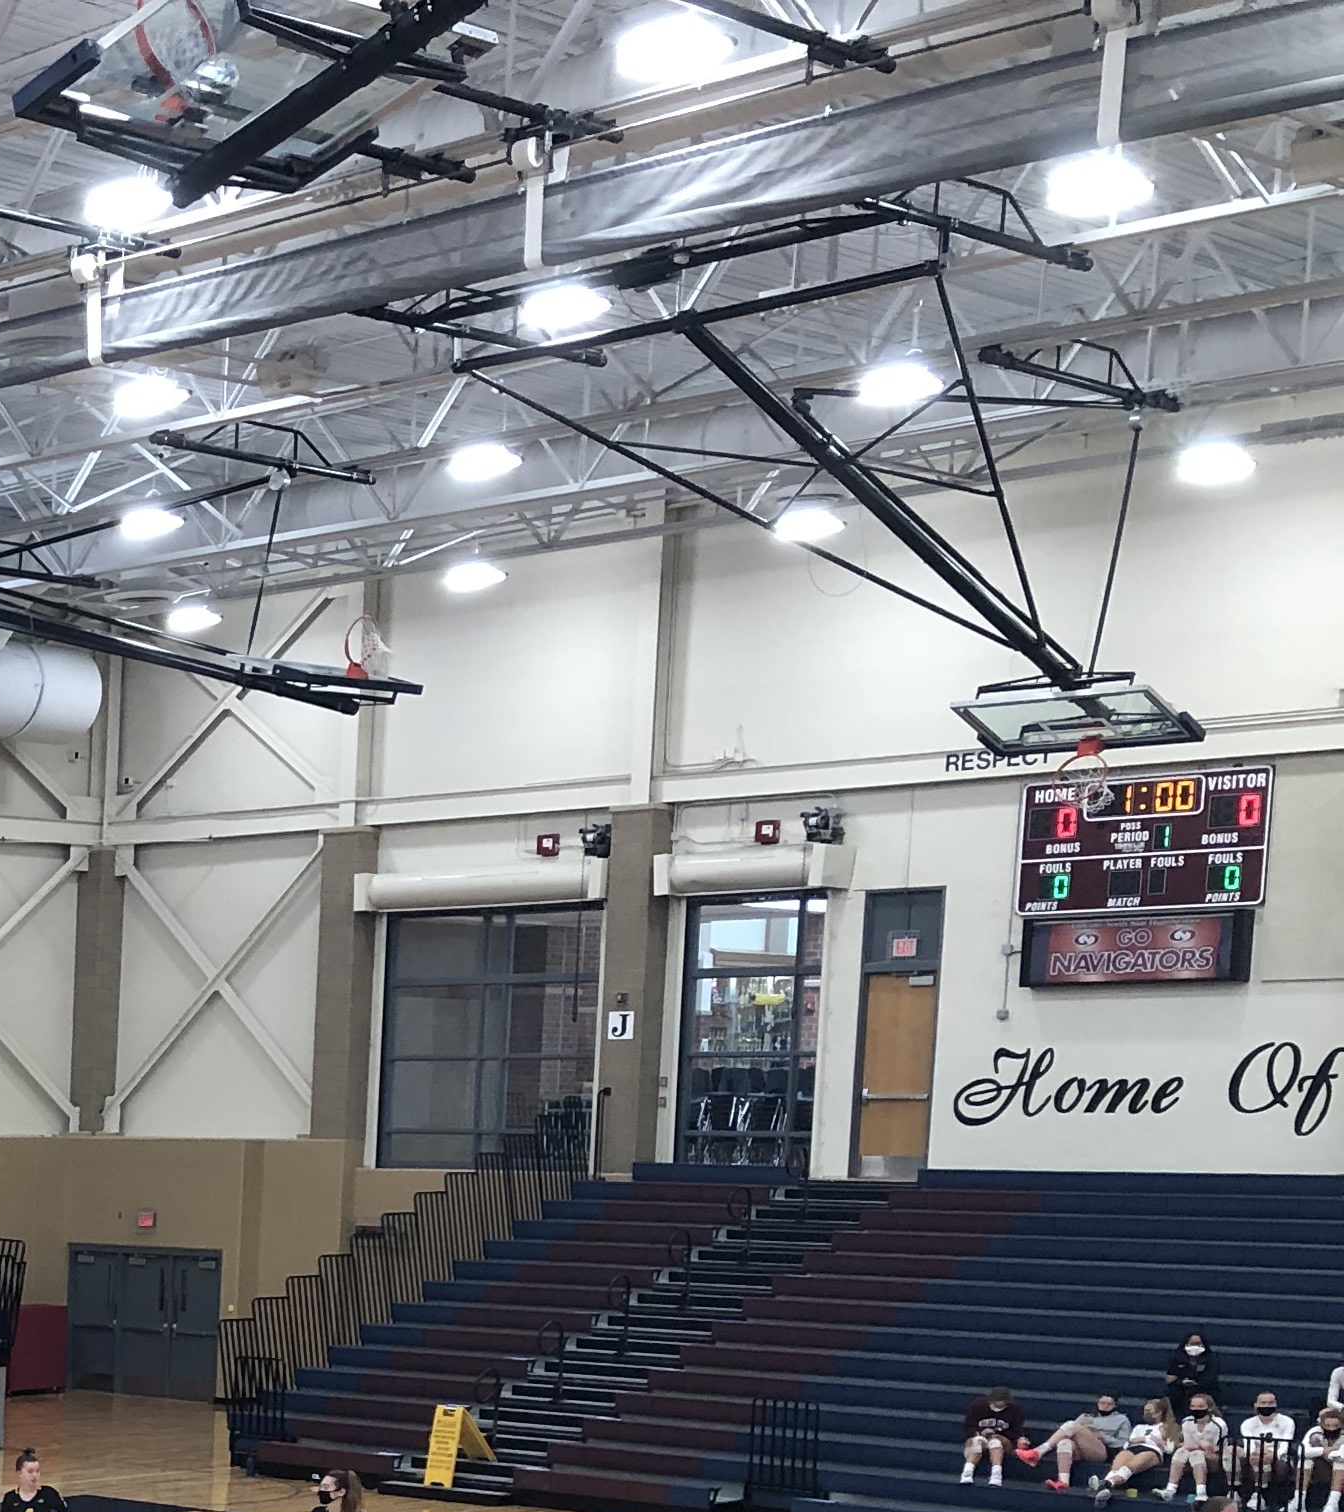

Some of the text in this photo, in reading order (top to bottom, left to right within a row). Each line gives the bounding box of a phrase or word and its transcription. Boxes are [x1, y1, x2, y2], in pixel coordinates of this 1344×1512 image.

[1207, 773, 1267, 791] VISITOR
[1034, 788, 1076, 803] HOME
[1124, 780, 1195, 813] 1:00
[1238, 794, 1261, 825] 0
[1057, 807, 1077, 838] 0
[1110, 831, 1149, 843] PERIOD
[1201, 832, 1239, 845] BONUS
[1046, 842, 1081, 854] BONUS
[1103, 856, 1185, 870] PLAYER FOULS
[1208, 852, 1243, 864] FOULS
[1039, 863, 1072, 874] FOULS
[1053, 875, 1069, 899] 0
[1224, 866, 1240, 890] 0
[1116, 929, 1152, 947] GO
[1050, 947, 1213, 975] NAVIGATORS
[612, 1014, 630, 1037] J
[953, 1041, 1344, 1136] Home Of
